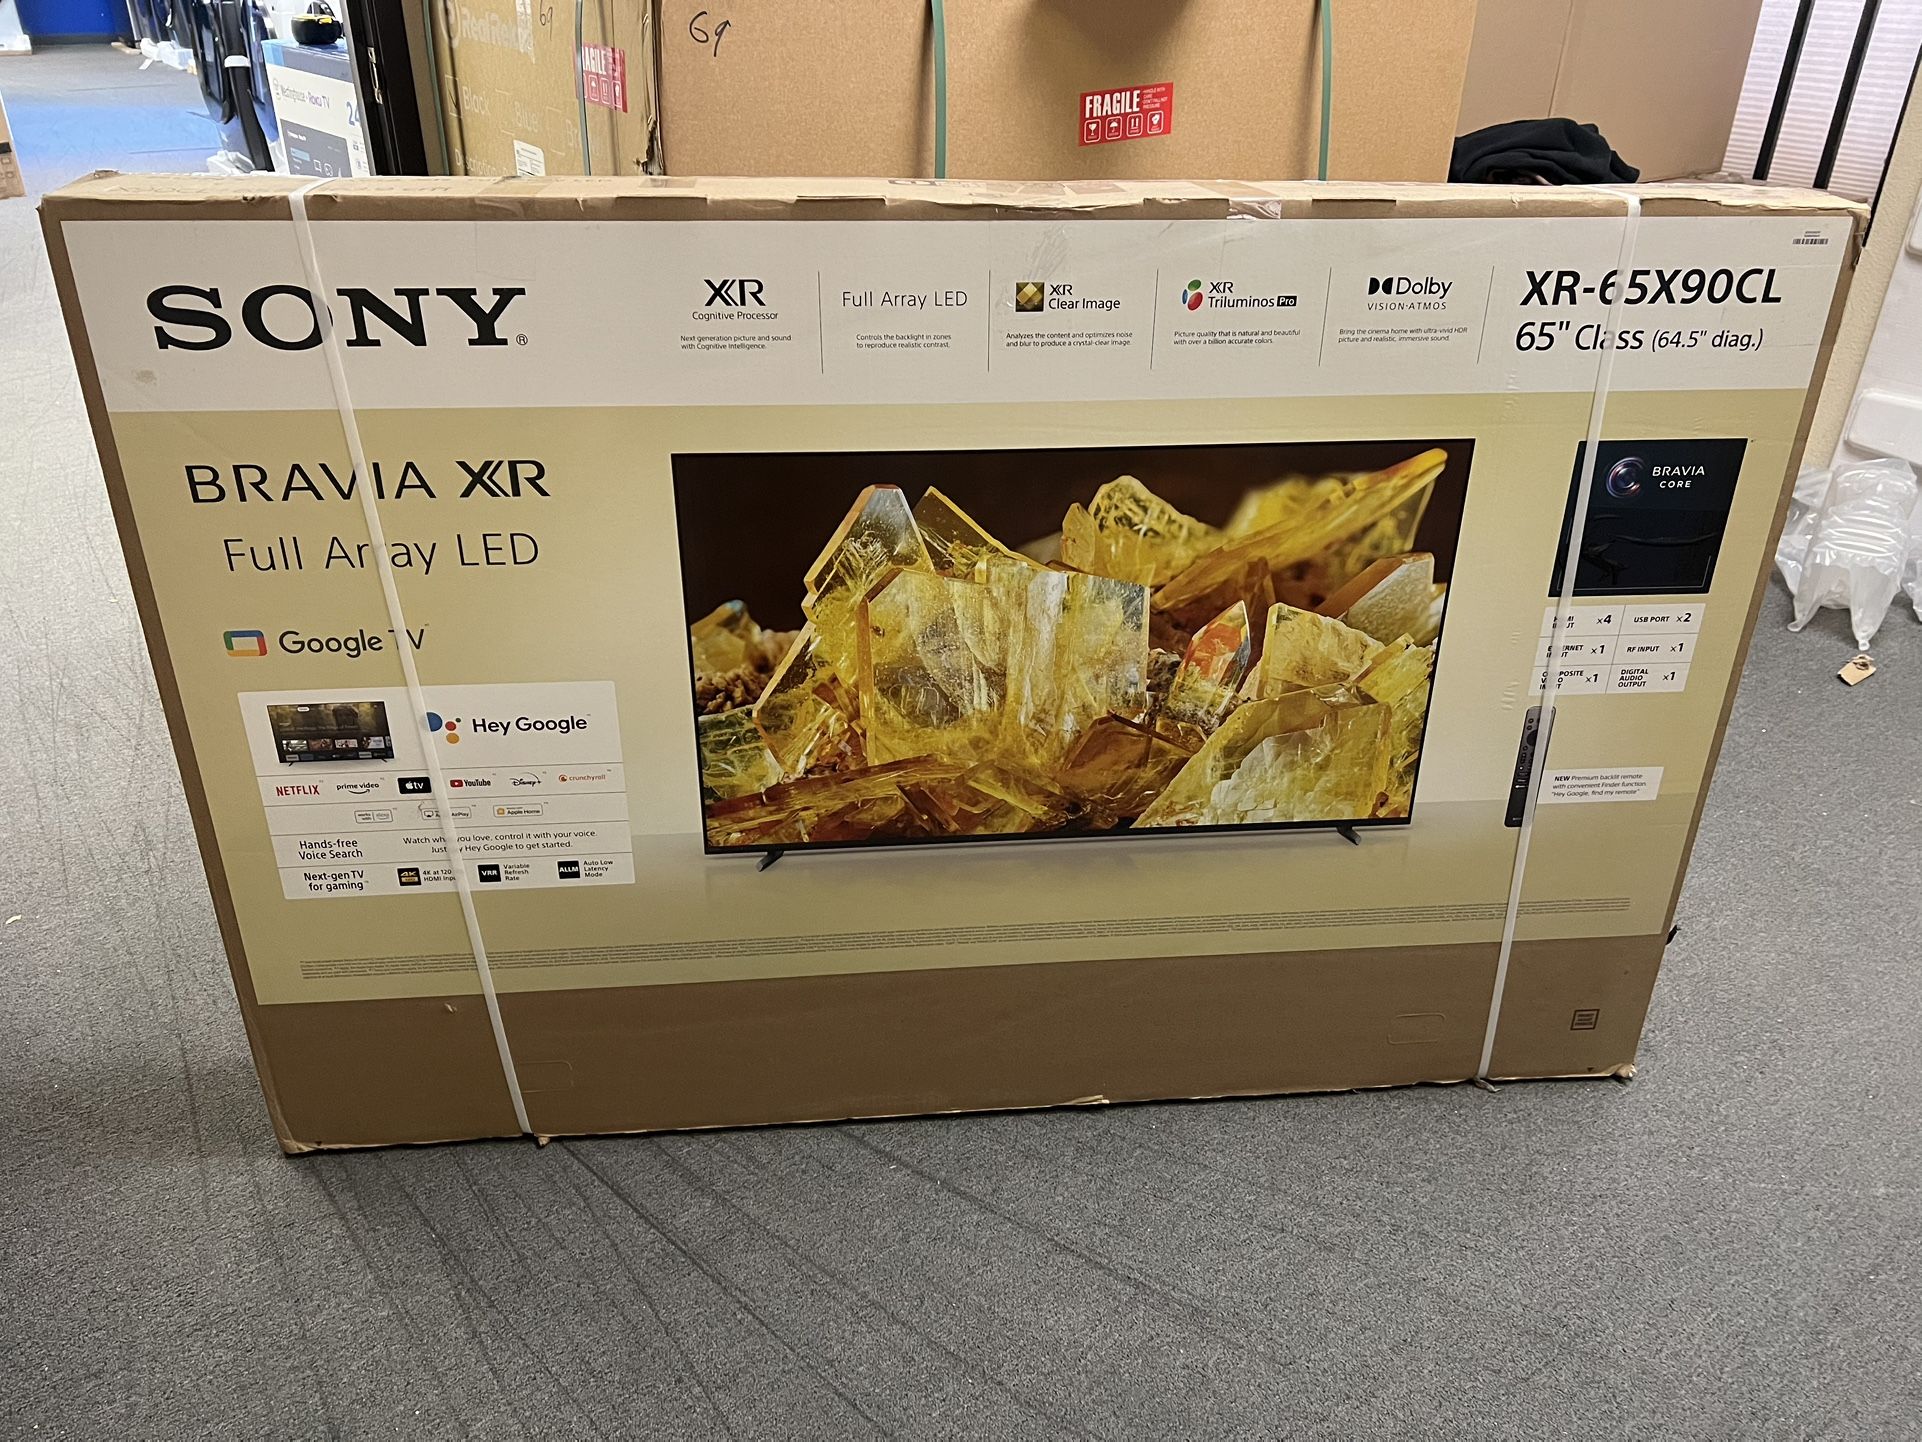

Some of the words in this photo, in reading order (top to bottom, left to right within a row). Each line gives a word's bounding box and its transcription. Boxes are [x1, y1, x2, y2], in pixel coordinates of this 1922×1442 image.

[463, 86, 491, 116] Black
[1085, 90, 1141, 119] FRAGILE
[1050, 284, 1074, 296] XR
[1209, 282, 1234, 293] XR
[1396, 277, 1454, 300] Dolby
[1520, 268, 1783, 306] XR-65X90CL
[704, 279, 767, 307] XR
[842, 291, 874, 307] Full
[881, 291, 928, 310] Array
[935, 291, 968, 307] LED
[1048, 298, 1080, 310] Clear
[1083, 298, 1121, 312] Image
[1208, 296, 1275, 308] Triluminos
[1279, 297, 1296, 306] Pro
[146, 284, 526, 351] SONY
[692, 311, 735, 322] Cognitive
[737, 311, 779, 321] Processor
[1006, 332, 1034, 341] Analyzes
[1047, 332, 1071, 340] content
[1085, 331, 1115, 341] optimizes
[1116, 330, 1133, 338] noise
[1197, 331, 1217, 340] quality
[1339, 328, 1356, 336] Bring
[1454, 326, 1468, 334] HDR
[1515, 320, 1571, 351] 65"
[1575, 324, 1645, 351] Class
[1652, 328, 1708, 353] (64.5"
[1712, 328, 1764, 352] diag.)
[697, 335, 733, 344] generation
[734, 335, 757, 343] picture
[856, 334, 883, 342] Controls
[896, 334, 925, 342] backlight
[1338, 336, 1359, 344] picture
[696, 342, 727, 352] Cognitive
[865, 342, 897, 351] reproduce
[923, 341, 952, 349] contrast.
[1041, 340, 1067, 349] produce
[1073, 339, 1109, 348] crystal-clear
[1652, 466, 1706, 477] BRAVIA
[184, 461, 437, 504] BRAVIA
[455, 459, 552, 498] XR
[1660, 480, 1692, 489] CORE
[223, 536, 303, 572] Full
[325, 536, 437, 575] Aray
[457, 532, 539, 567] LED
[1650, 615, 1670, 623] PORT
[279, 629, 384, 659] Google
[1638, 645, 1660, 653] INPUT
[1621, 668, 1649, 676] DIGITAL
[1619, 674, 1643, 682] AUDIO
[1617, 680, 1646, 688] OUTPUT
[472, 718, 511, 736] Hey
[515, 715, 588, 734] Google
[463, 778, 492, 788] YouTube
[569, 774, 606, 783] crunchyroll
[275, 784, 321, 797] NETFLIX
[413, 781, 425, 790] tv
[402, 836, 430, 845] Watch
[472, 834, 492, 842] love,
[494, 833, 524, 841] control
[553, 832, 571, 840] your
[573, 830, 598, 838] voice.
[299, 838, 358, 851] Hands-free
[431, 846, 448, 854] Just
[465, 844, 481, 853] Hey
[483, 843, 514, 852] Google
[525, 842, 540, 851] get
[542, 841, 573, 849] started.
[298, 850, 327, 861] Voice
[329, 848, 364, 860] Search
[583, 865, 608, 873] Latency
[304, 871, 350, 885] Next-gen
[350, 870, 364, 879] TV
[309, 882, 323, 892] for
[325, 881, 364, 893] gaming
